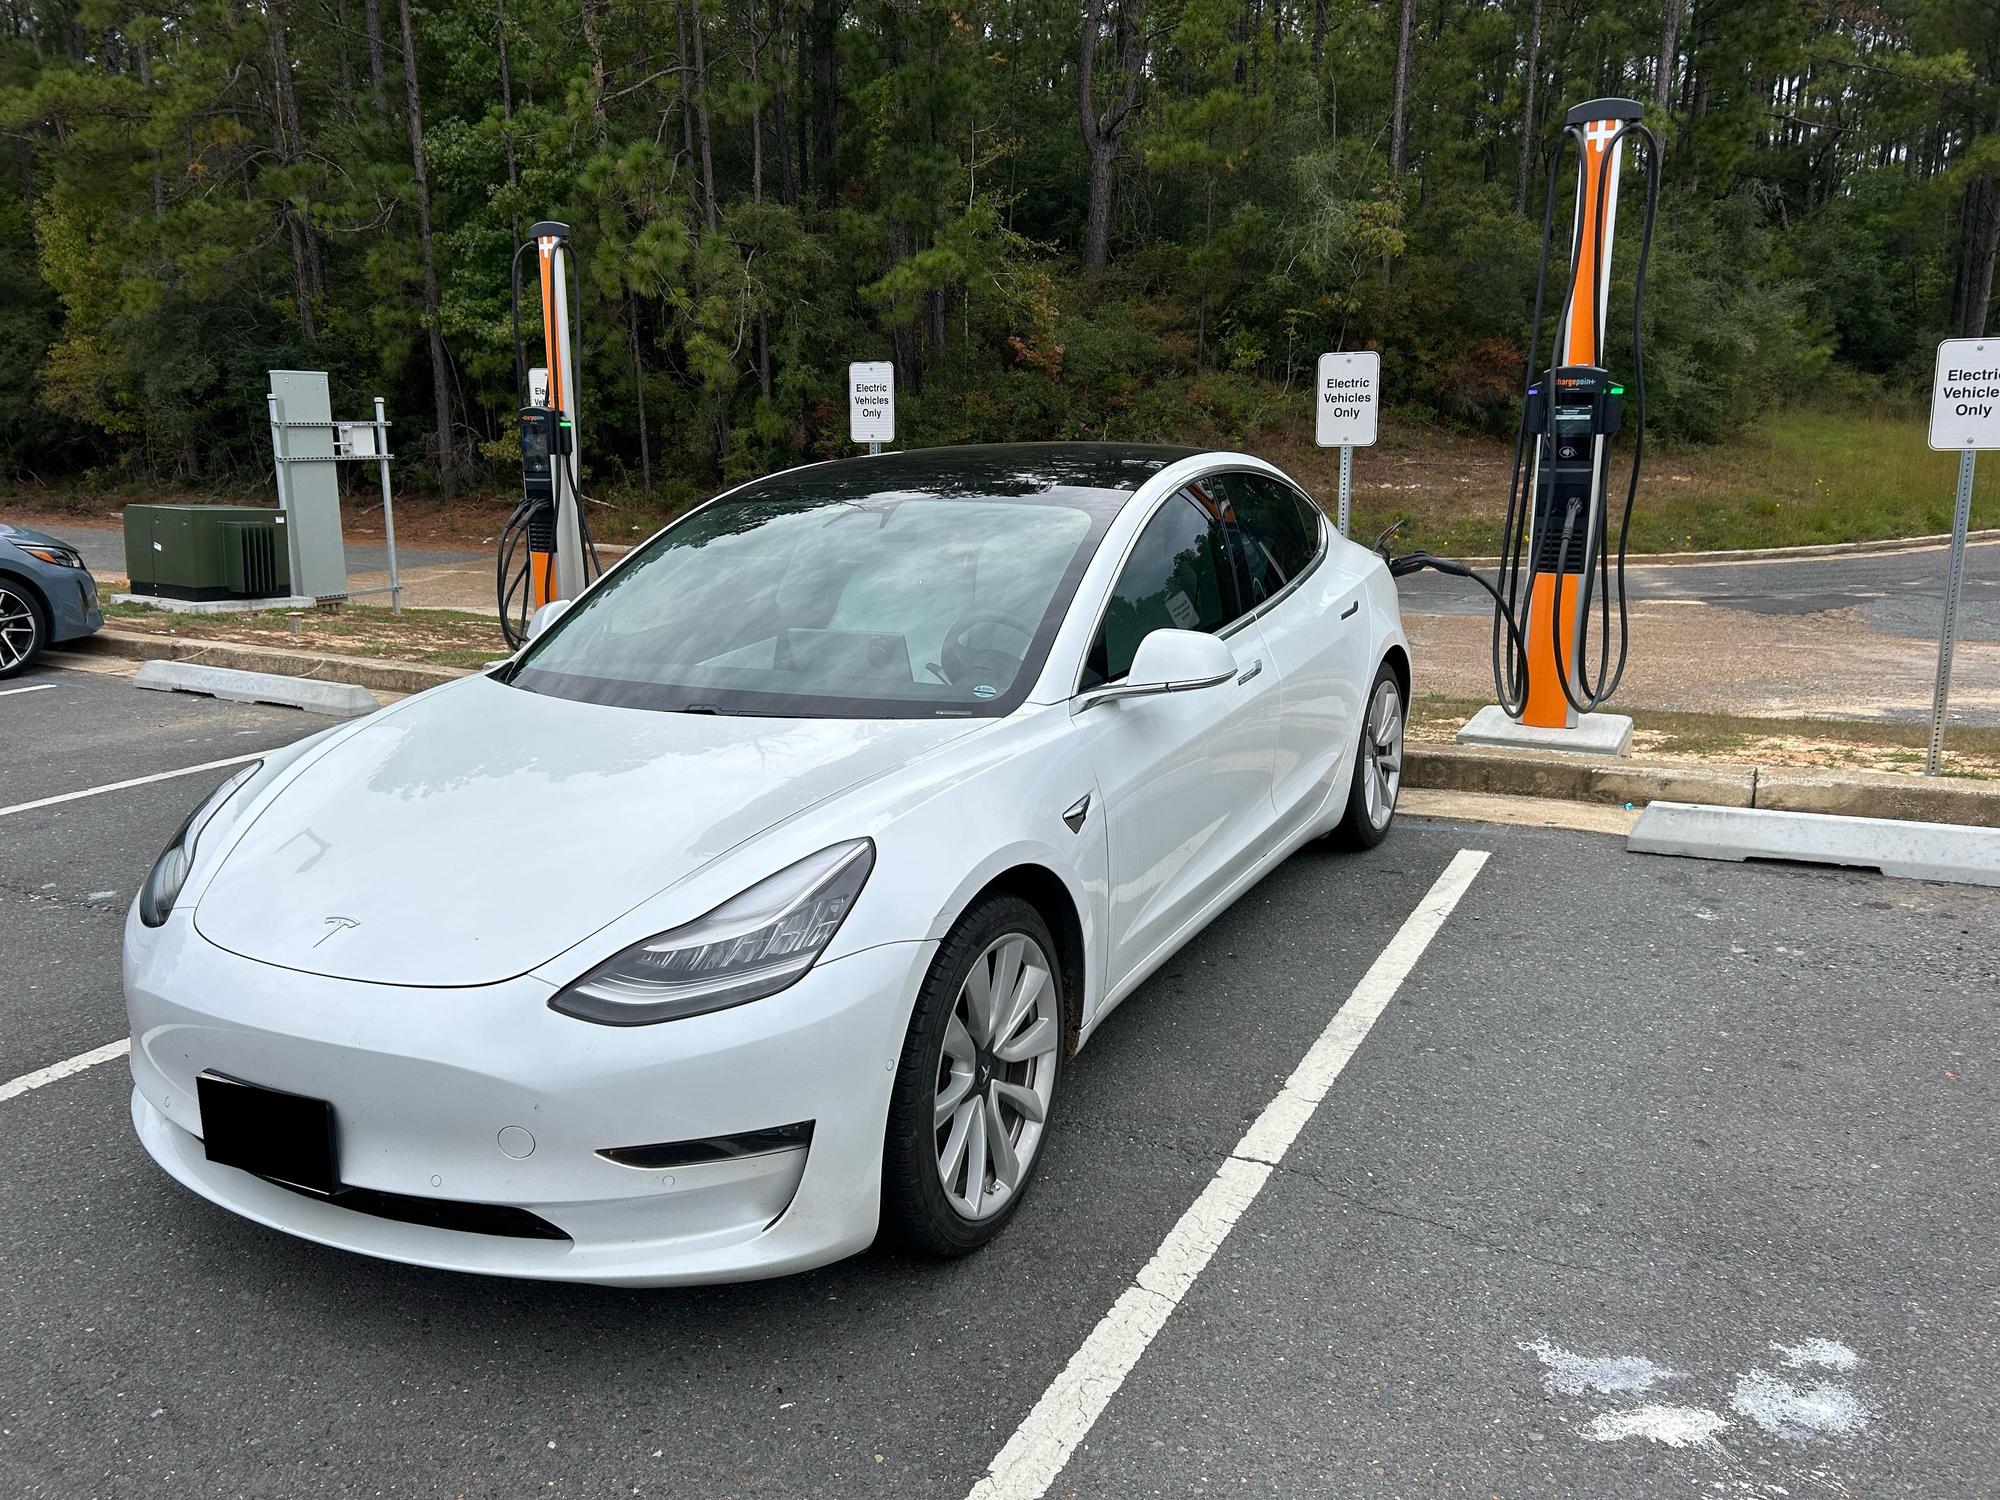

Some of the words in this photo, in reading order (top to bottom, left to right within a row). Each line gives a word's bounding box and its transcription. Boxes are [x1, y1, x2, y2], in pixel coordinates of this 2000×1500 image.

[1948, 368, 2000, 382] Electri
[856, 383, 887, 393] Electric
[1327, 377, 1370, 389] Electric
[1324, 393, 1371, 403] Vehicles
[1943, 386, 2000, 399] Vehicle
[855, 396, 889, 405] Vehicles
[862, 408, 882, 419] Only
[1334, 407, 1361, 420] Only
[1956, 404, 1993, 418] Only
